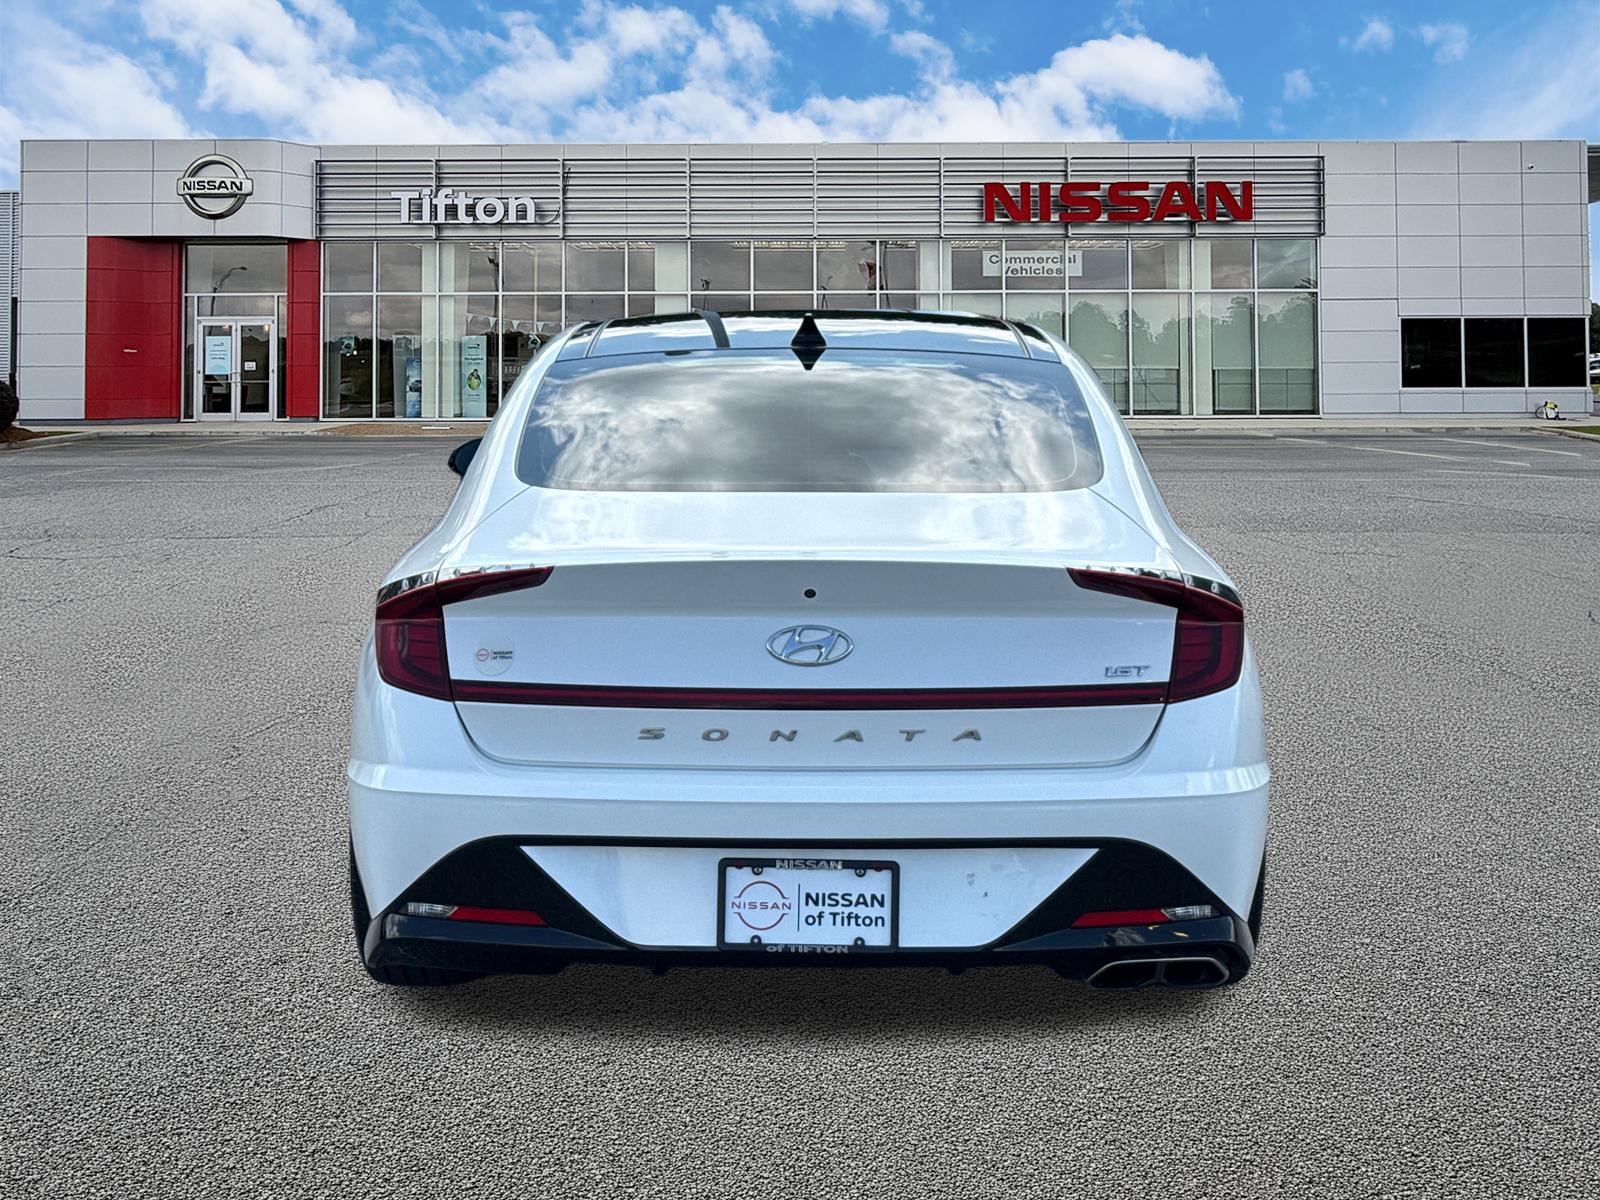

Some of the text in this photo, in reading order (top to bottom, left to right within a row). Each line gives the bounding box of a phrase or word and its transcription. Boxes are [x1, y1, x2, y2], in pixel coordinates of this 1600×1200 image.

[183, 180, 243, 191] NISSAN
[391, 187, 536, 224] Tifton
[983, 180, 1253, 222] NISSAN
[637, 727, 982, 742] SONATA
[775, 859, 843, 871] NISSAN
[731, 901, 792, 911] NISSAN
[804, 892, 885, 908] NISSAN
[804, 911, 885, 928] of Tifton
[766, 944, 849, 954] of TIFTON
